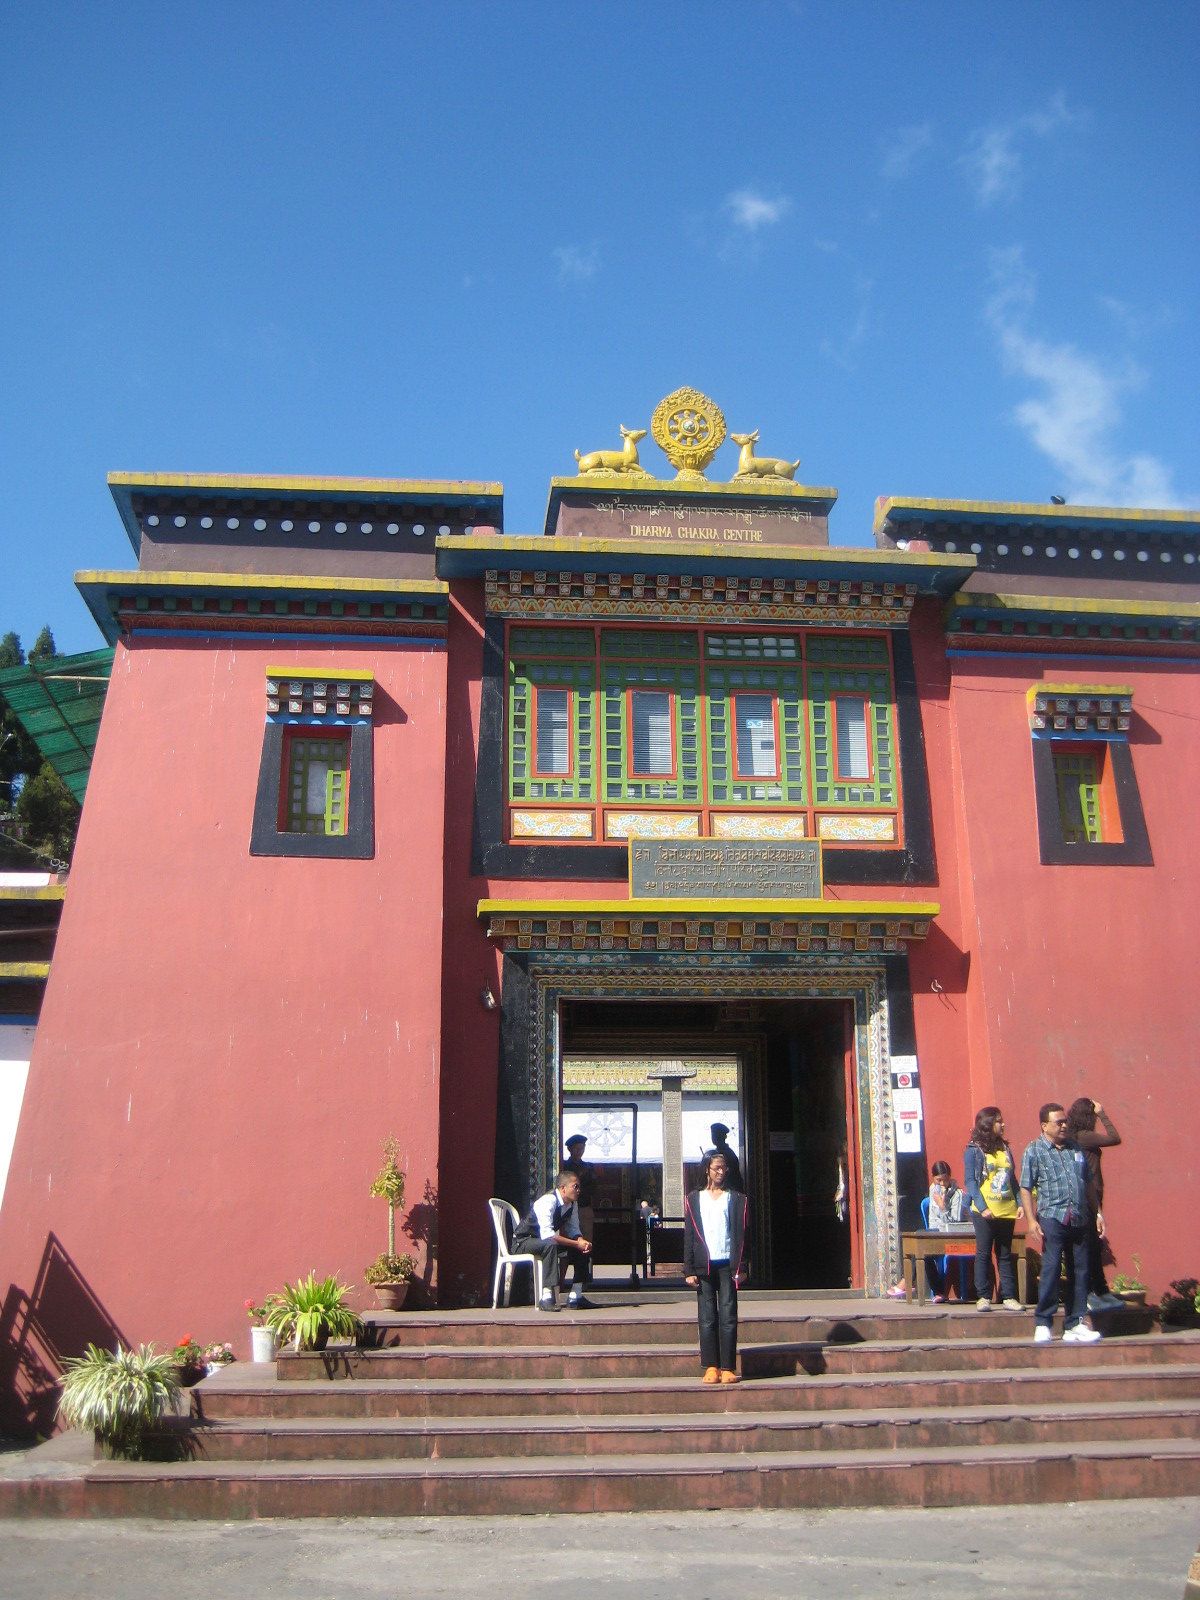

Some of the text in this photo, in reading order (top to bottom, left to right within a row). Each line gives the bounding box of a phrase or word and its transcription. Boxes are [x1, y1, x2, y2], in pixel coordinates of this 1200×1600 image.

[630, 524, 763, 542] DHARMA CHAKRA CENTRE
